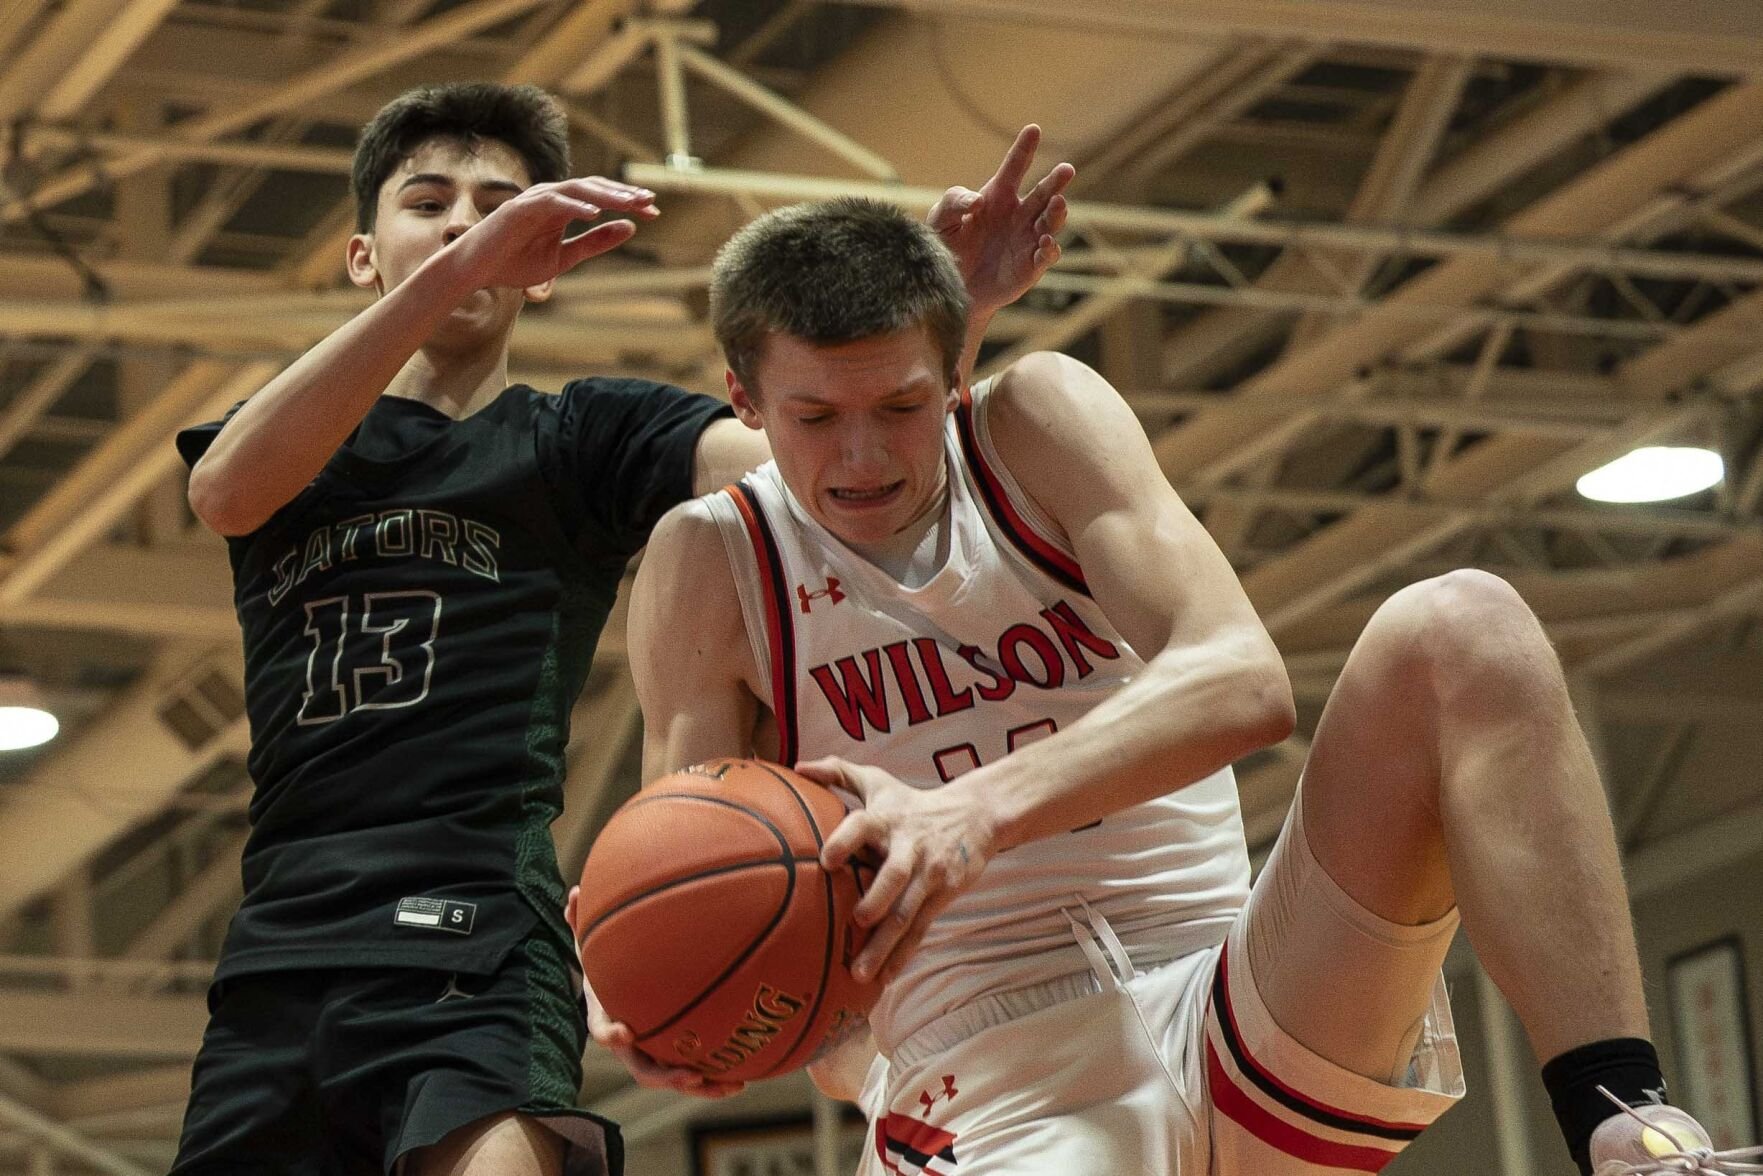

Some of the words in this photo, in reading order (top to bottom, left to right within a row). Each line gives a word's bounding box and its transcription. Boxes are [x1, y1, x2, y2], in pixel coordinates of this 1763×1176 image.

[296, 589, 442, 726] 13
[808, 599, 1121, 742] WILSON
[451, 908, 464, 923] S
